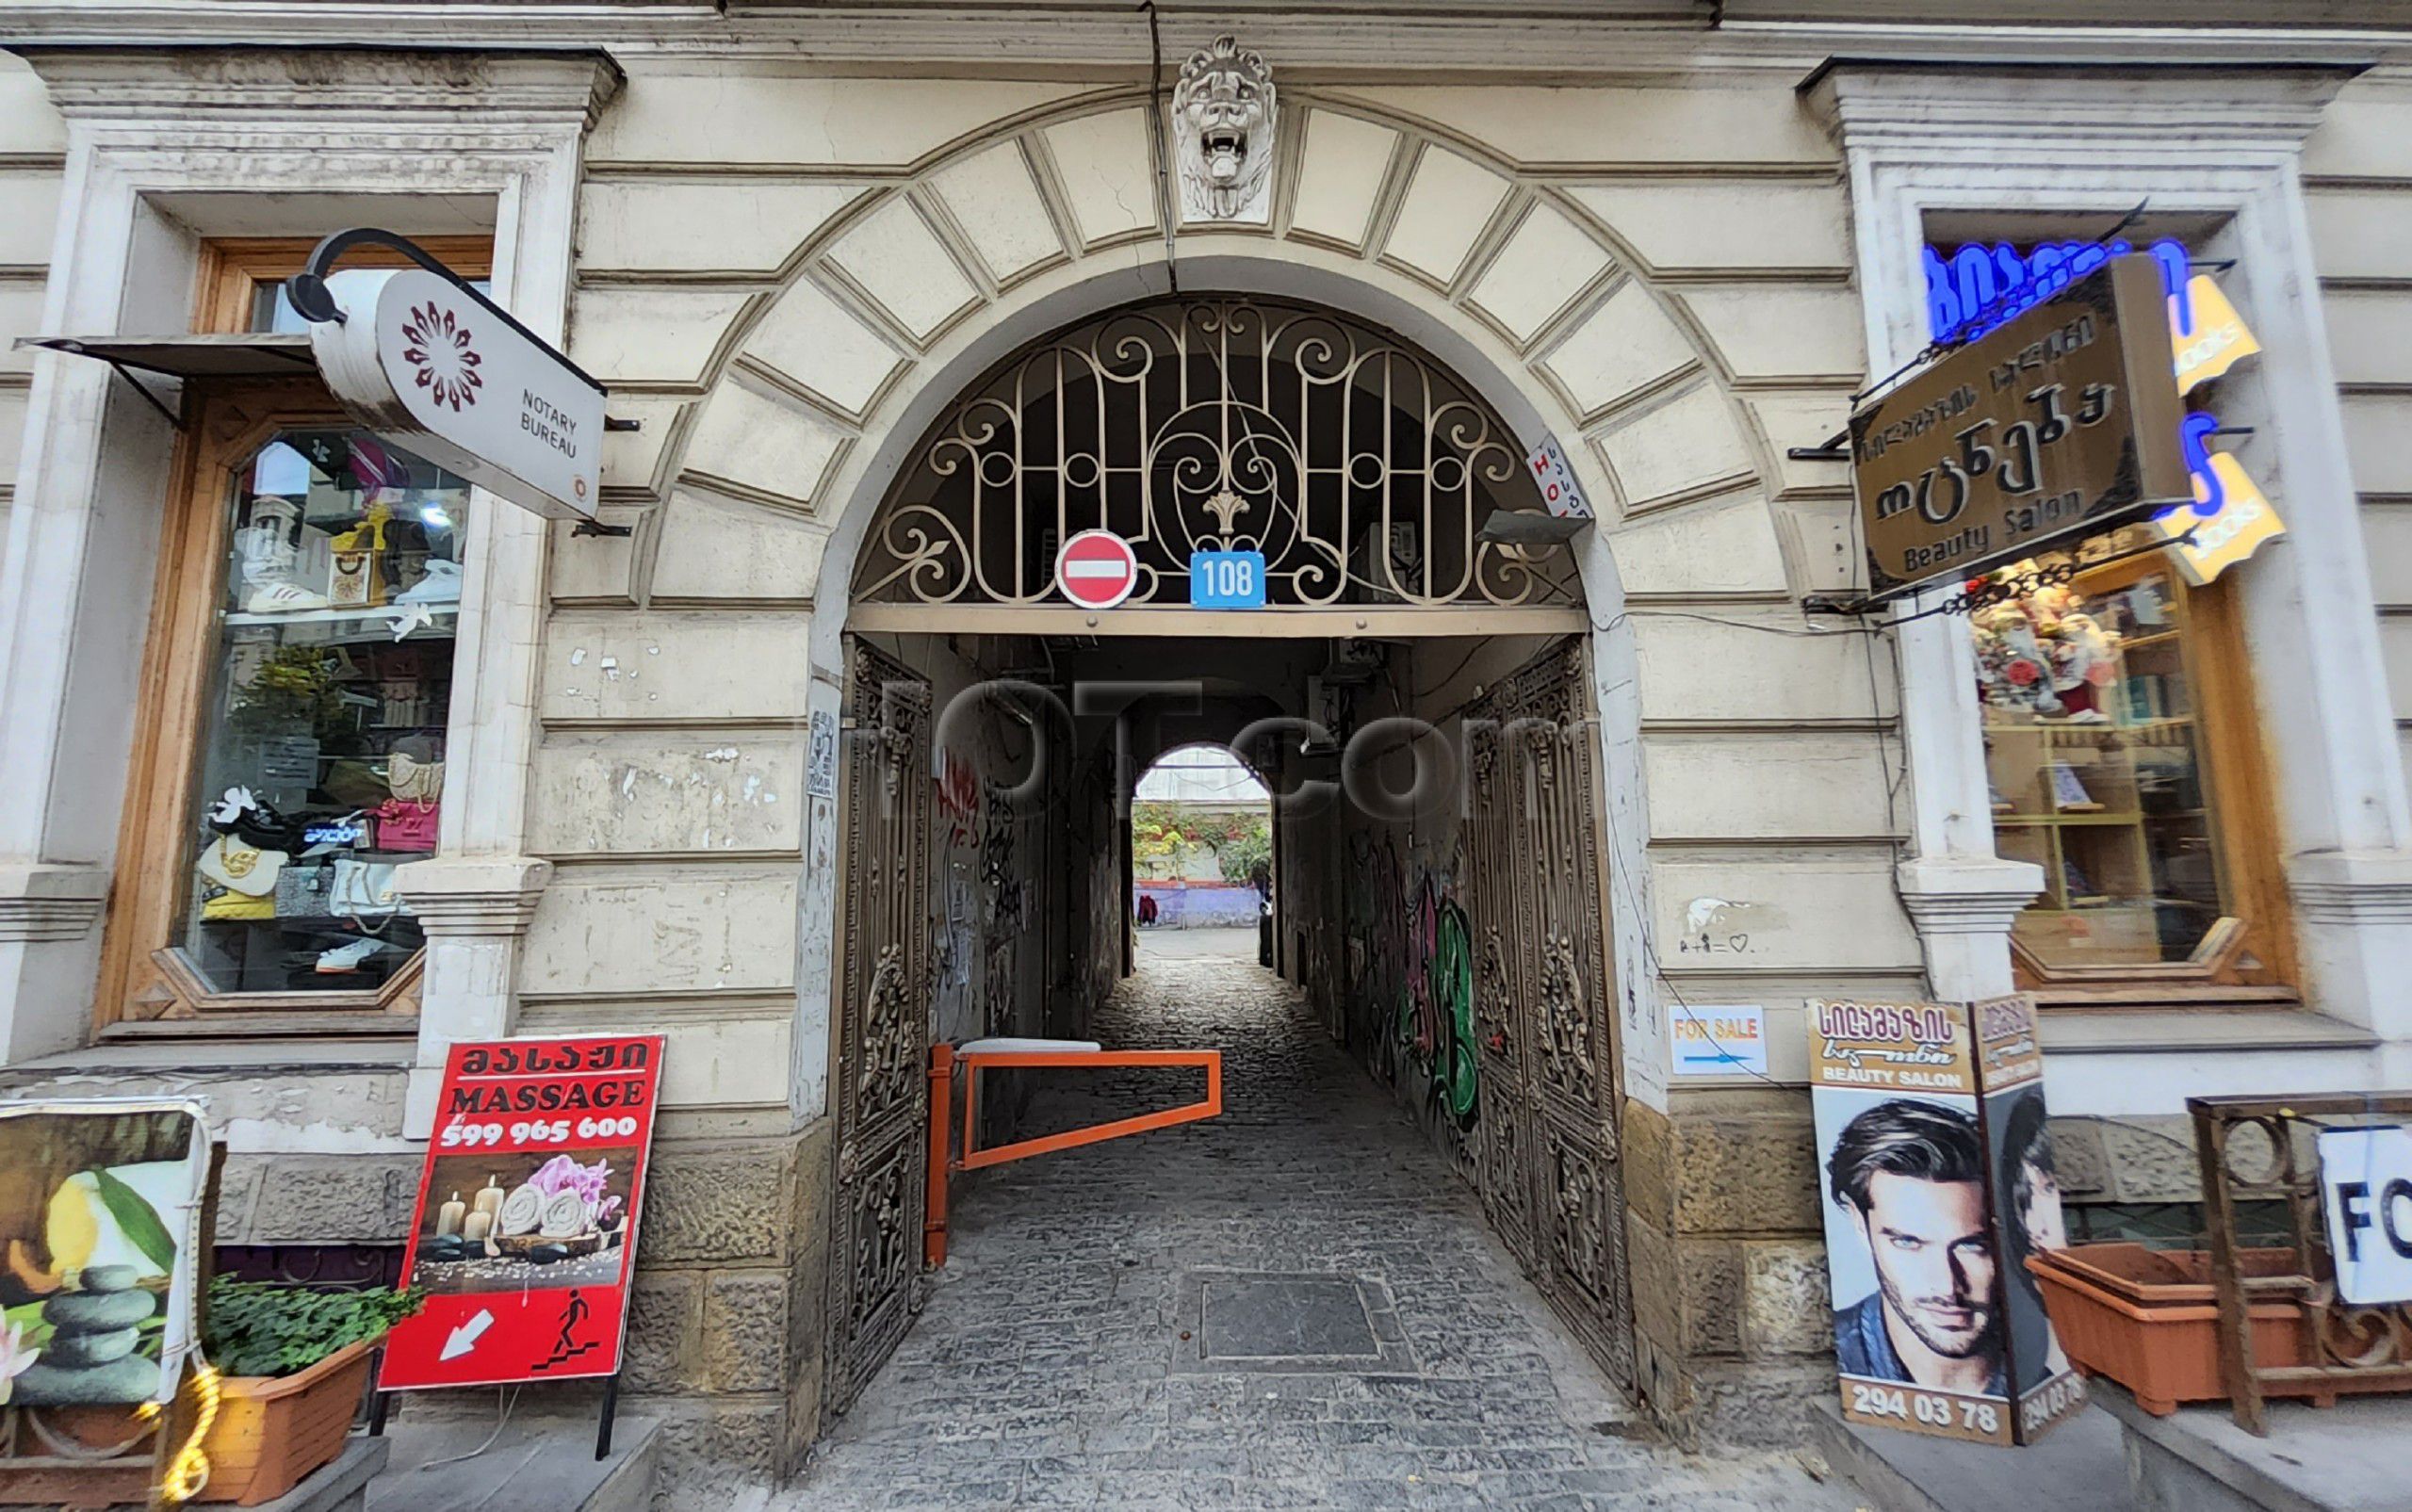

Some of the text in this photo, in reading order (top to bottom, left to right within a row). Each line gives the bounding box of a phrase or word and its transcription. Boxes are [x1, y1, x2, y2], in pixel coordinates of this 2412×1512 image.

[523, 388, 577, 435] NOTARY
[521, 412, 576, 459] BUREAU
[1533, 453, 1569, 518] HO
[1903, 525, 1990, 573] Beauty
[1202, 560, 1253, 596] 108
[1674, 1018, 1758, 1040] FOR SALE
[1817, 1003, 1954, 1043] სილამაზის
[462, 1042, 648, 1074] მასაჟი
[1822, 1065, 1963, 1088] BEAUTY SALON
[448, 1080, 646, 1114] MASSAGE
[440, 1115, 638, 1147] 599 965 600
[1852, 1385, 1998, 1435] 294 03 78
